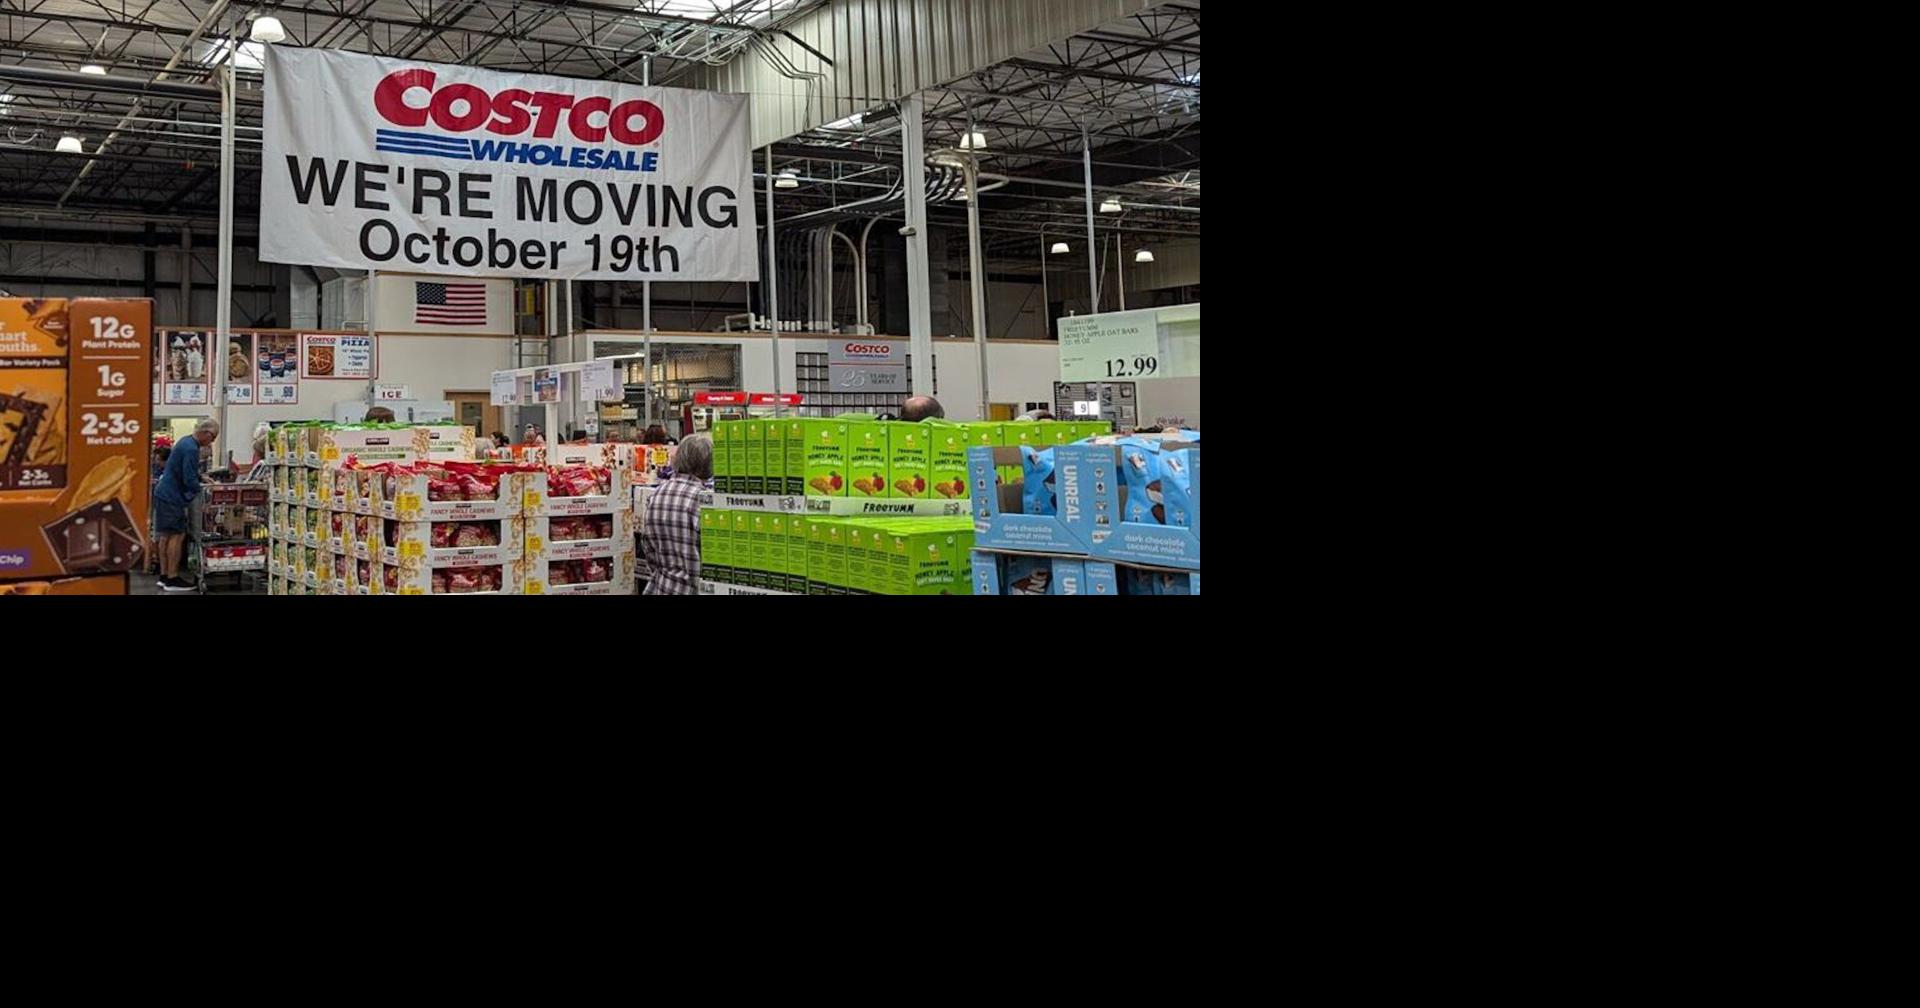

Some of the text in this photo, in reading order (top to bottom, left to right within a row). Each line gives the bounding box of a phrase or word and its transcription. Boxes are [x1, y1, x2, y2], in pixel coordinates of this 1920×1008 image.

[374, 68, 664, 145] COSTCO
[469, 139, 659, 172] WHOLESALE
[285, 155, 739, 229] WE'RE MOVING
[359, 218, 680, 273] October 19th
[1087, 330, 1105, 338] APPLE
[82, 340, 141, 349] Plant Protein
[845, 343, 890, 353] COSTCO
[13, 359, 41, 367] Variety
[1105, 356, 1157, 377] 12.99
[840, 368, 865, 388] 25
[97, 388, 125, 398] Sugar
[1080, 403, 1087, 413] 9
[86, 436, 133, 445] Net Carbs
[911, 456, 926, 464] APPLE
[1063, 464, 1081, 523] UNREAL
[725, 496, 765, 508] FROOYUMM
[863, 502, 914, 513] FROOYUMM
[1003, 524, 1052, 533] dark chocolate
[1005, 531, 1053, 541] coconut minis
[1124, 534, 1185, 547] dark chocolate
[1126, 543, 1159, 553] coconut
[1160, 545, 1185, 556] minis
[915, 569, 954, 578] HONEY APPLE
